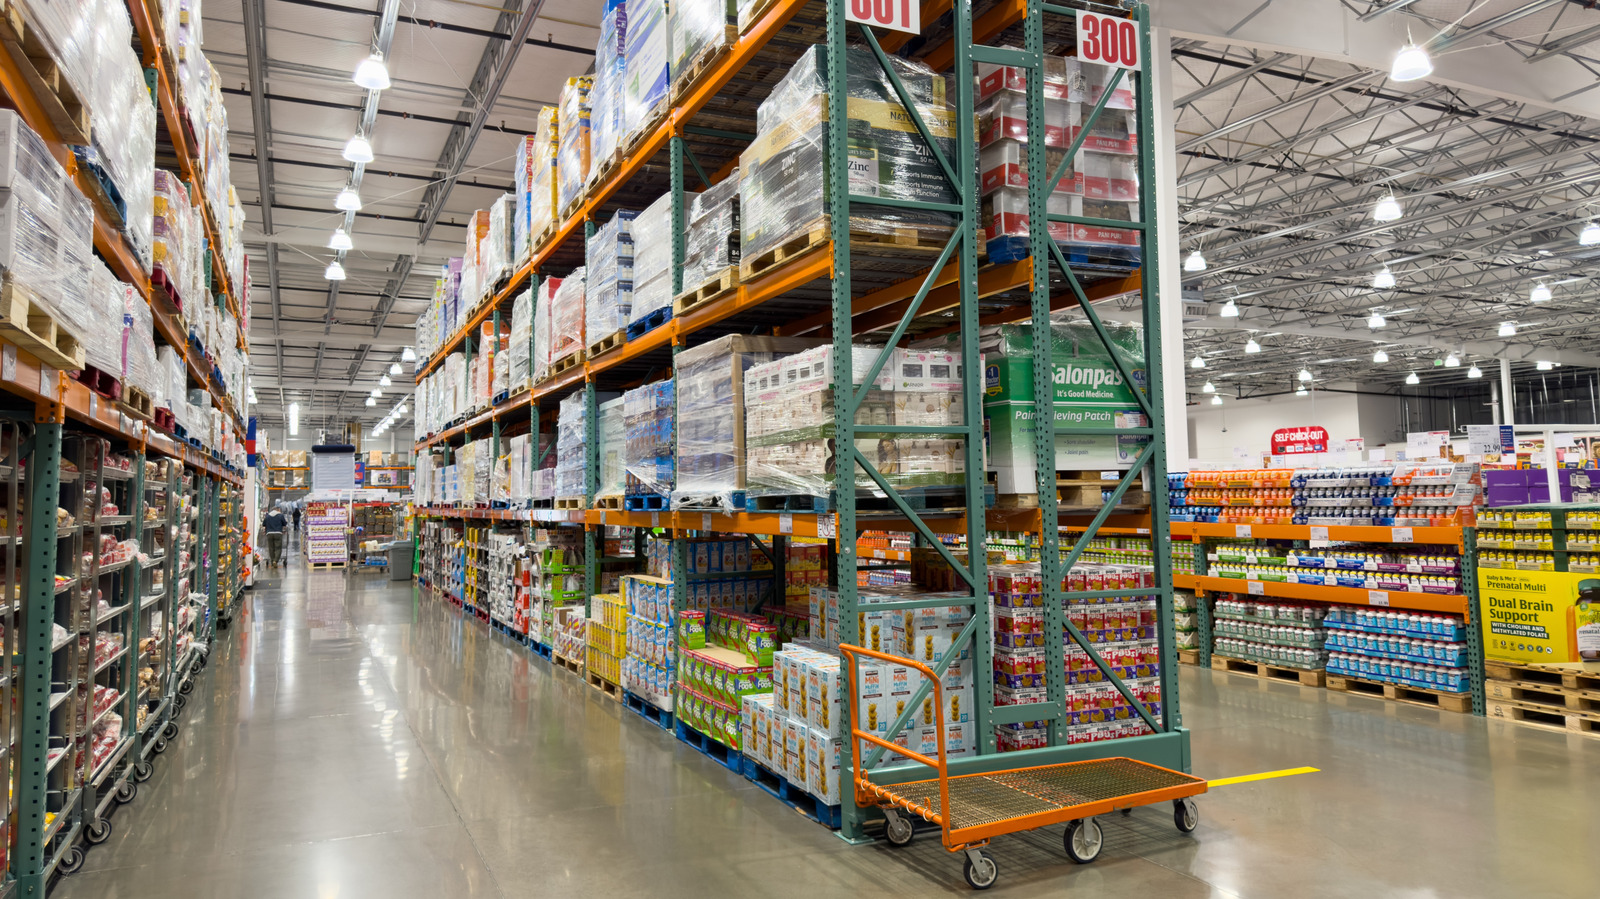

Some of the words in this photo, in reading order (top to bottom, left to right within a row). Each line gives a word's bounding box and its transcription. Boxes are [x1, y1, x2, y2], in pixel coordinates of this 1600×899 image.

[1082, 15, 1137, 66] 300
[916, 144, 934, 157] ZIN
[781, 151, 796, 171] ZINC
[848, 161, 869, 172] Zinc
[921, 172, 944, 181] Immune
[921, 183, 944, 191] Immune
[1054, 411, 1082, 422] ieving
[1084, 412, 1111, 420] Patch
[1275, 433, 1289, 442] SELF
[1289, 430, 1324, 441] CHECK-OUT
[1487, 581, 1522, 590] Prenatal
[1524, 582, 1547, 592] Multi
[1489, 596, 1516, 609] Dual
[1520, 599, 1553, 612] Brain
[1490, 609, 1539, 623] Support
[1492, 628, 1526, 637] METHYLATED
[1507, 623, 1530, 631] CHOLINE
